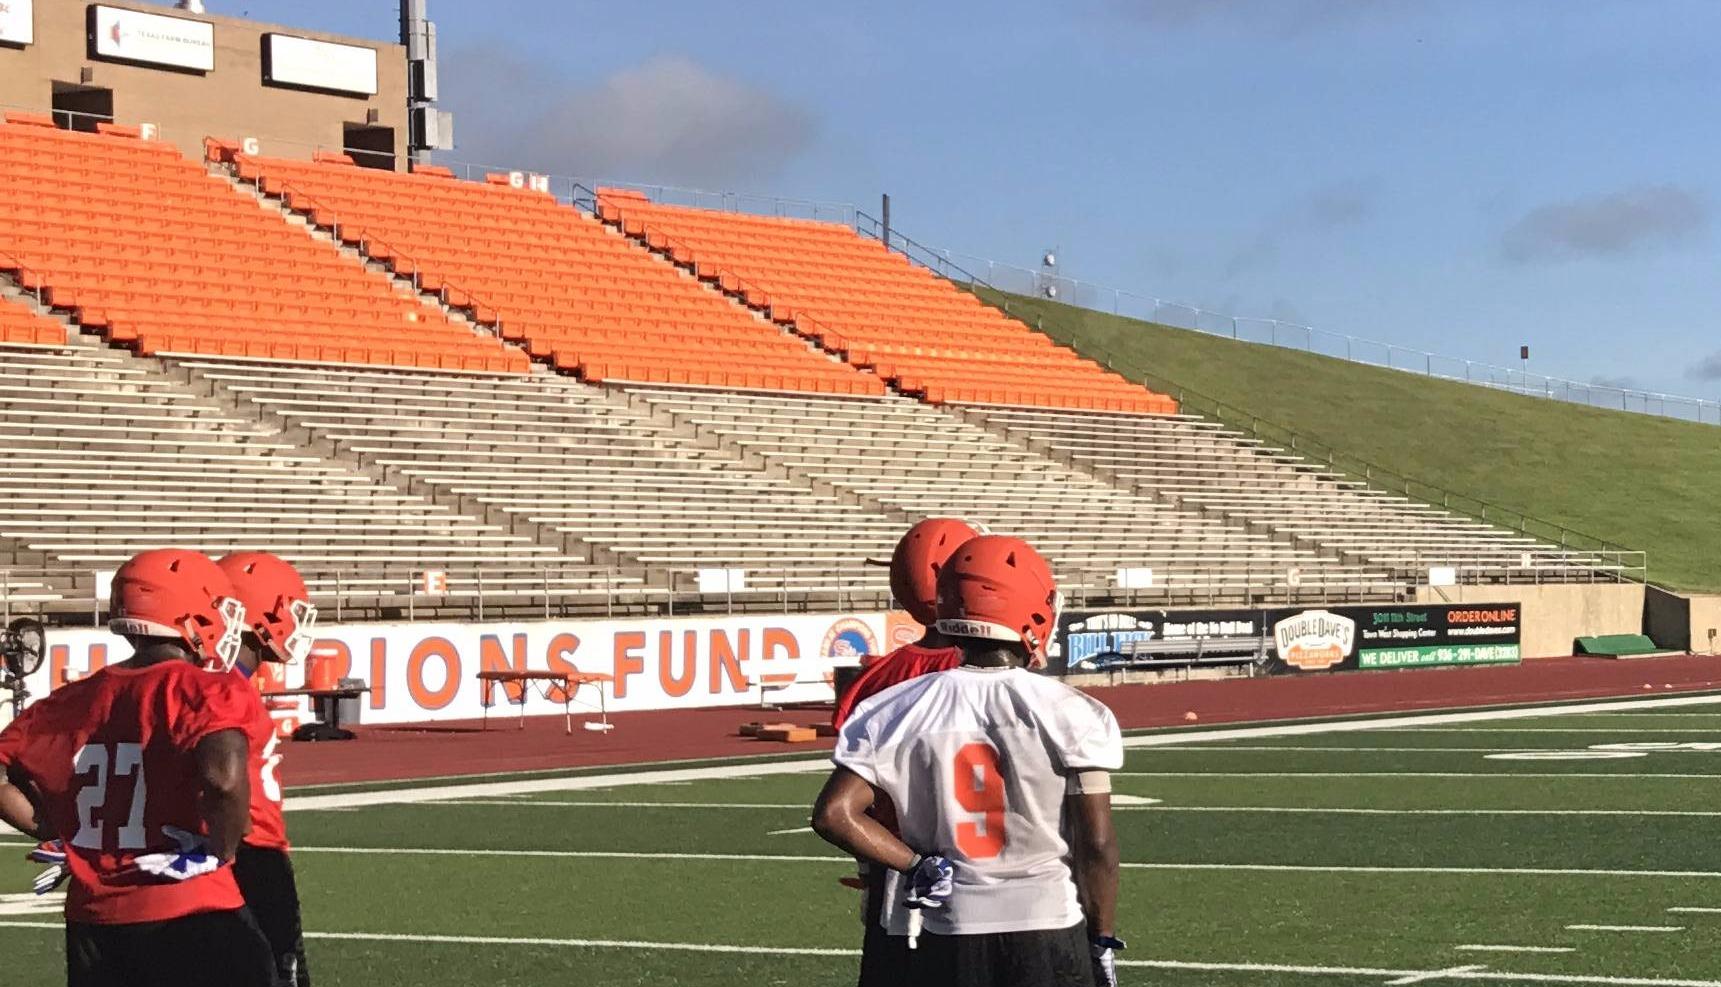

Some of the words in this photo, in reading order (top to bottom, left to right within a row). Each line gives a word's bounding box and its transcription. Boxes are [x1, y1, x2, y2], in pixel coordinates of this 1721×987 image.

[243, 137, 259, 155] G
[1447, 610, 1480, 623] ORDER
[1481, 609, 1517, 622] ONLINE
[1361, 653, 1377, 665] WE
[1380, 650, 1419, 664] DELIVER
[71, 742, 147, 850] 27
[953, 742, 1006, 861] 9
